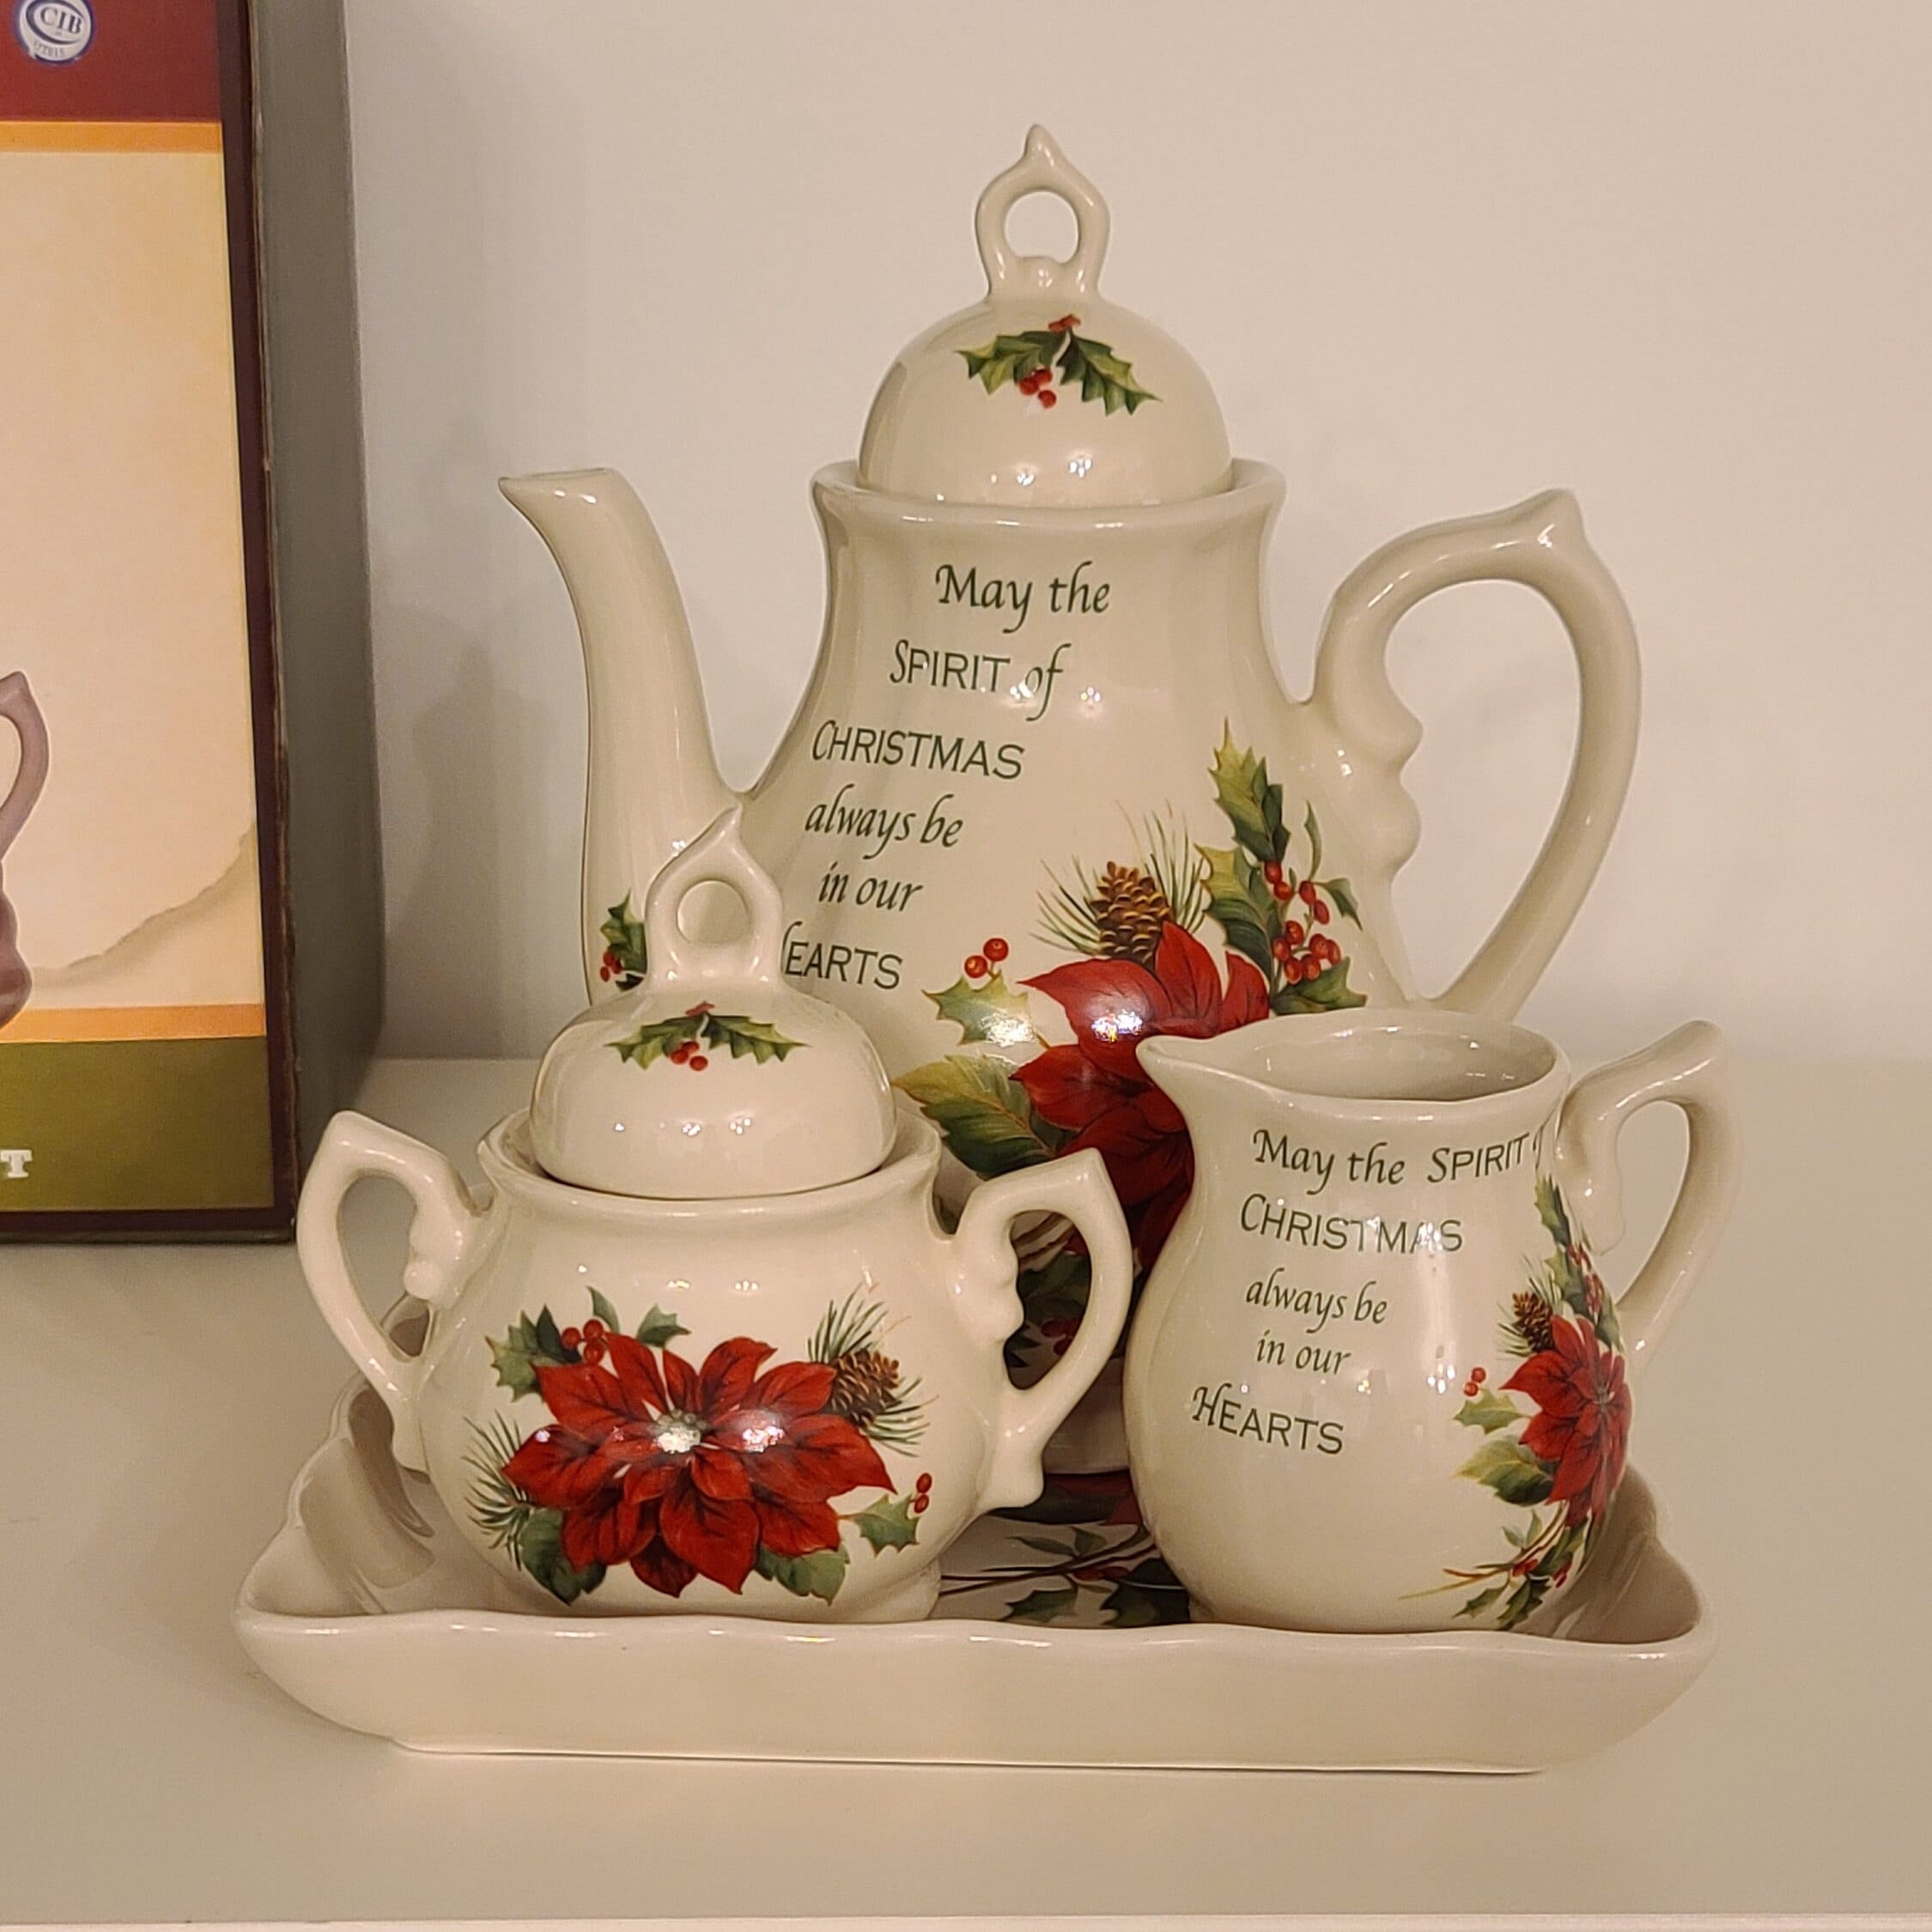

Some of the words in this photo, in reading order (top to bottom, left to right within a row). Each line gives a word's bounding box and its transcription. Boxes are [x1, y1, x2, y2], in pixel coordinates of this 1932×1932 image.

[39, 6, 82, 34] CIB
[934, 563, 1032, 634] May
[1048, 560, 1110, 614] the
[890, 639, 1011, 693] SPIRIT
[1022, 643, 1072, 721] of
[811, 720, 1025, 780] CHRISTMAS
[805, 784, 916, 860] always
[919, 794, 963, 847] be
[817, 861, 848, 903] in
[854, 876, 924, 912] our
[1252, 1128, 1335, 1195] May
[1347, 1141, 1406, 1185] the
[1426, 1132, 1530, 1182] SPIRIT
[1245, 1267, 1347, 1334] always
[1353, 1279, 1388, 1324] be
[1255, 1328, 1285, 1366] in
[1295, 1345, 1352, 1375] our
[1192, 1382, 1345, 1455] HEARTS
